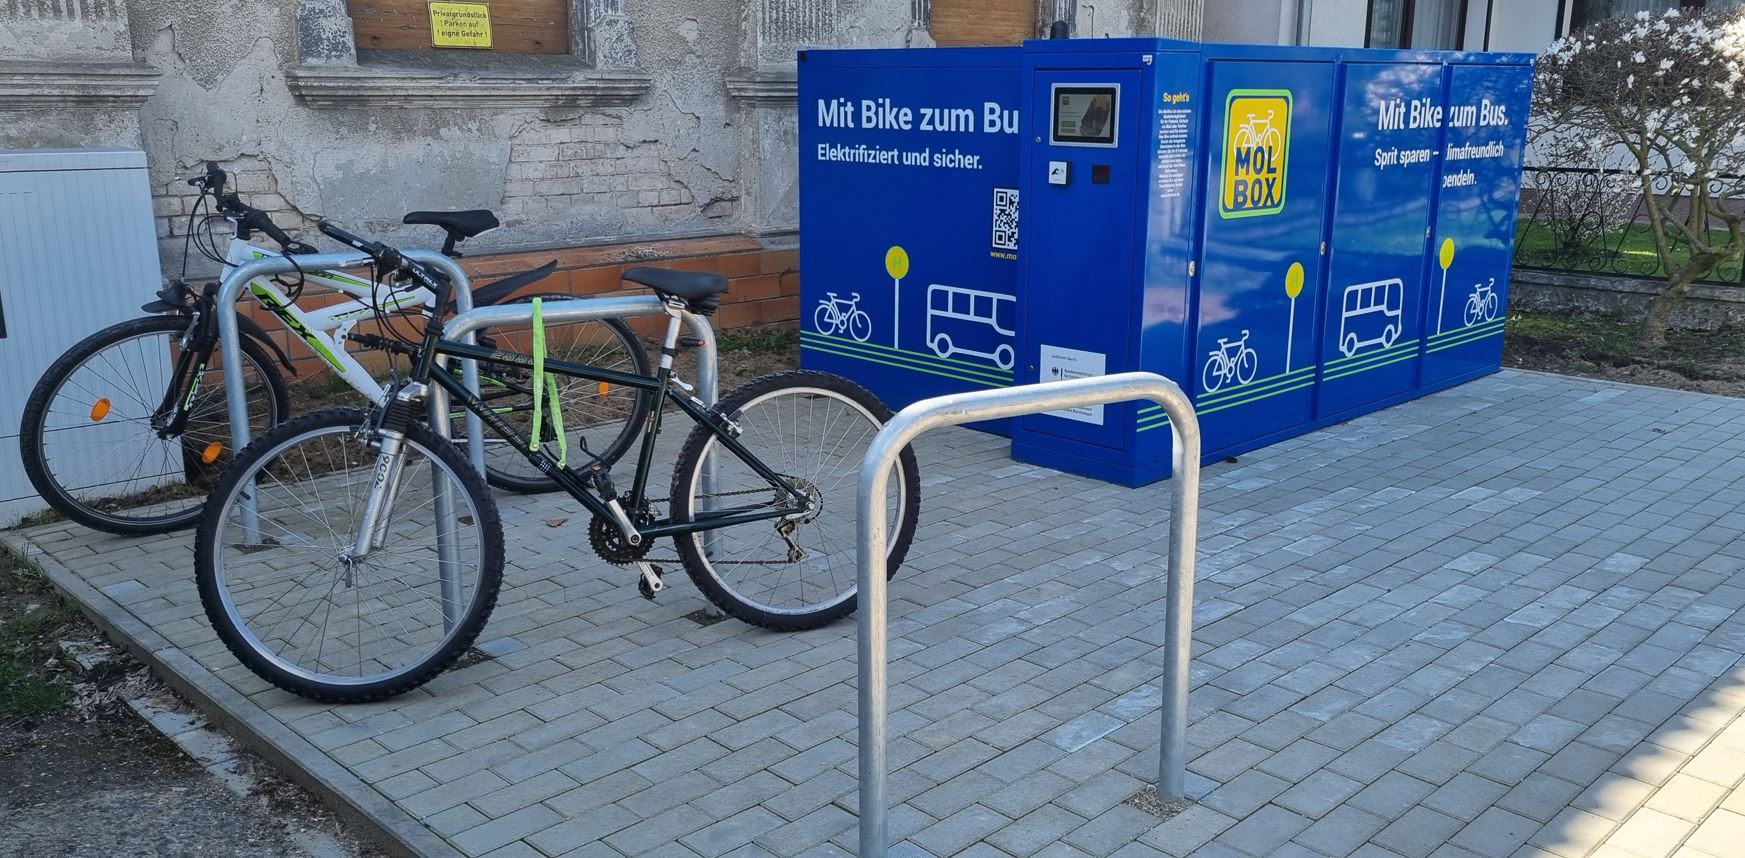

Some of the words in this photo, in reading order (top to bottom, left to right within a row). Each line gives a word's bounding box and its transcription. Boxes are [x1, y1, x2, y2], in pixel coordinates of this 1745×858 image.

[433, 10, 487, 19] Privatgrundstück
[444, 19, 467, 28] Parken
[441, 29, 460, 38] eigne
[461, 30, 484, 38] Gefahr
[1163, 92, 1171, 102] So
[817, 97, 855, 128] Mit
[861, 98, 913, 130] Bike
[919, 106, 975, 133] zum
[1378, 98, 1406, 131] Mit
[1409, 98, 1443, 129] Bike
[1480, 98, 1509, 127] Bus.
[817, 143, 899, 165] Elektrifiziert
[902, 147, 930, 167] und
[933, 149, 983, 170] sicher.
[1234, 145, 1277, 177] MOL
[1374, 146, 1398, 170] Sprit
[1400, 149, 1430, 168] sparen
[1233, 177, 1277, 209] BOX
